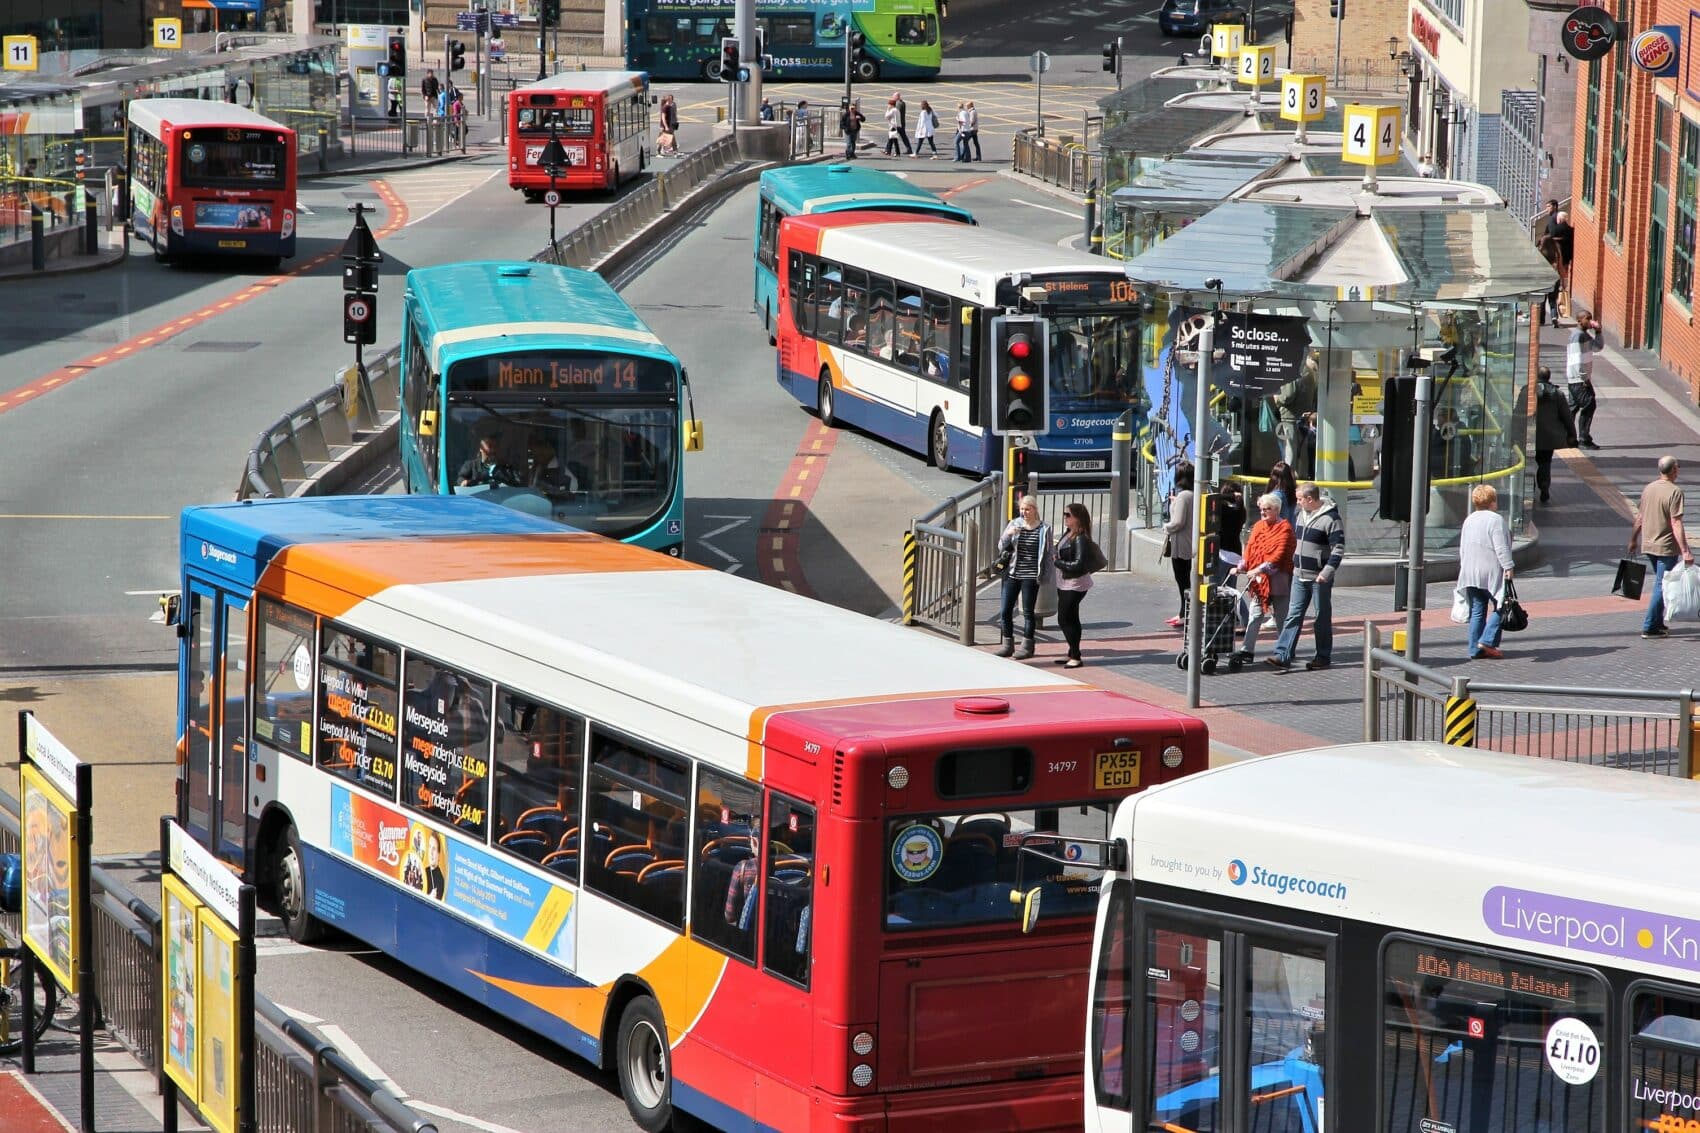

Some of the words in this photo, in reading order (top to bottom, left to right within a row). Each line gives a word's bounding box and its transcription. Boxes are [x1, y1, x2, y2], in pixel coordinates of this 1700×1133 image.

[159, 28, 176, 41] 12
[1219, 35, 1224, 48] 1
[1234, 35, 1238, 48] 1
[12, 46, 28, 61] 11
[1639, 35, 1666, 58] BURGER
[1643, 42, 1670, 66] KING
[773, 57, 832, 66] ROSSRIVER
[1245, 57, 1252, 74] 2
[1263, 57, 1269, 75] 2
[1288, 87, 1296, 108] 3
[1309, 88, 1318, 109] 3
[1354, 122, 1366, 148] 4
[1382, 122, 1393, 148] 4
[1044, 281, 1056, 292] St
[1059, 281, 1089, 292] Helens
[352, 306, 365, 317] 10
[1231, 325, 1245, 340] So
[1246, 327, 1289, 342] close...
[1261, 344, 1279, 352] away
[499, 361, 544, 389] Mann
[550, 361, 604, 389] Island
[613, 361, 636, 389] 14
[1071, 417, 1118, 429] Stagecoac
[208, 543, 237, 564] Stagecoach
[320, 672, 344, 693] Liverpool
[328, 693, 368, 720] megarider
[369, 706, 395, 731] £12.50
[405, 706, 449, 738] Merseyside
[320, 716, 344, 738] Liverpool
[339, 740, 372, 769] dayrider
[372, 756, 393, 779] £3.70
[412, 735, 463, 769] megariderplus
[1099, 753, 1138, 769] PX55
[404, 753, 447, 785] Merseyside
[1048, 761, 1078, 773] 34797
[1103, 771, 1132, 786] EGD
[418, 784, 462, 817] dayriderplus
[461, 804, 482, 825] £4.00
[379, 820, 409, 840] Summer
[1150, 855, 1182, 873] brought
[1184, 861, 1193, 873] to
[1195, 866, 1210, 878] you
[1213, 867, 1223, 881] by
[209, 872, 224, 898] Notice
[1251, 866, 1347, 900] Stagecoach
[1501, 895, 1625, 948] Liverpool
[1416, 953, 1450, 976] 10A
[1456, 961, 1505, 985] Mann
[1511, 971, 1570, 999] Island
[1550, 1038, 1597, 1066] £1.10
